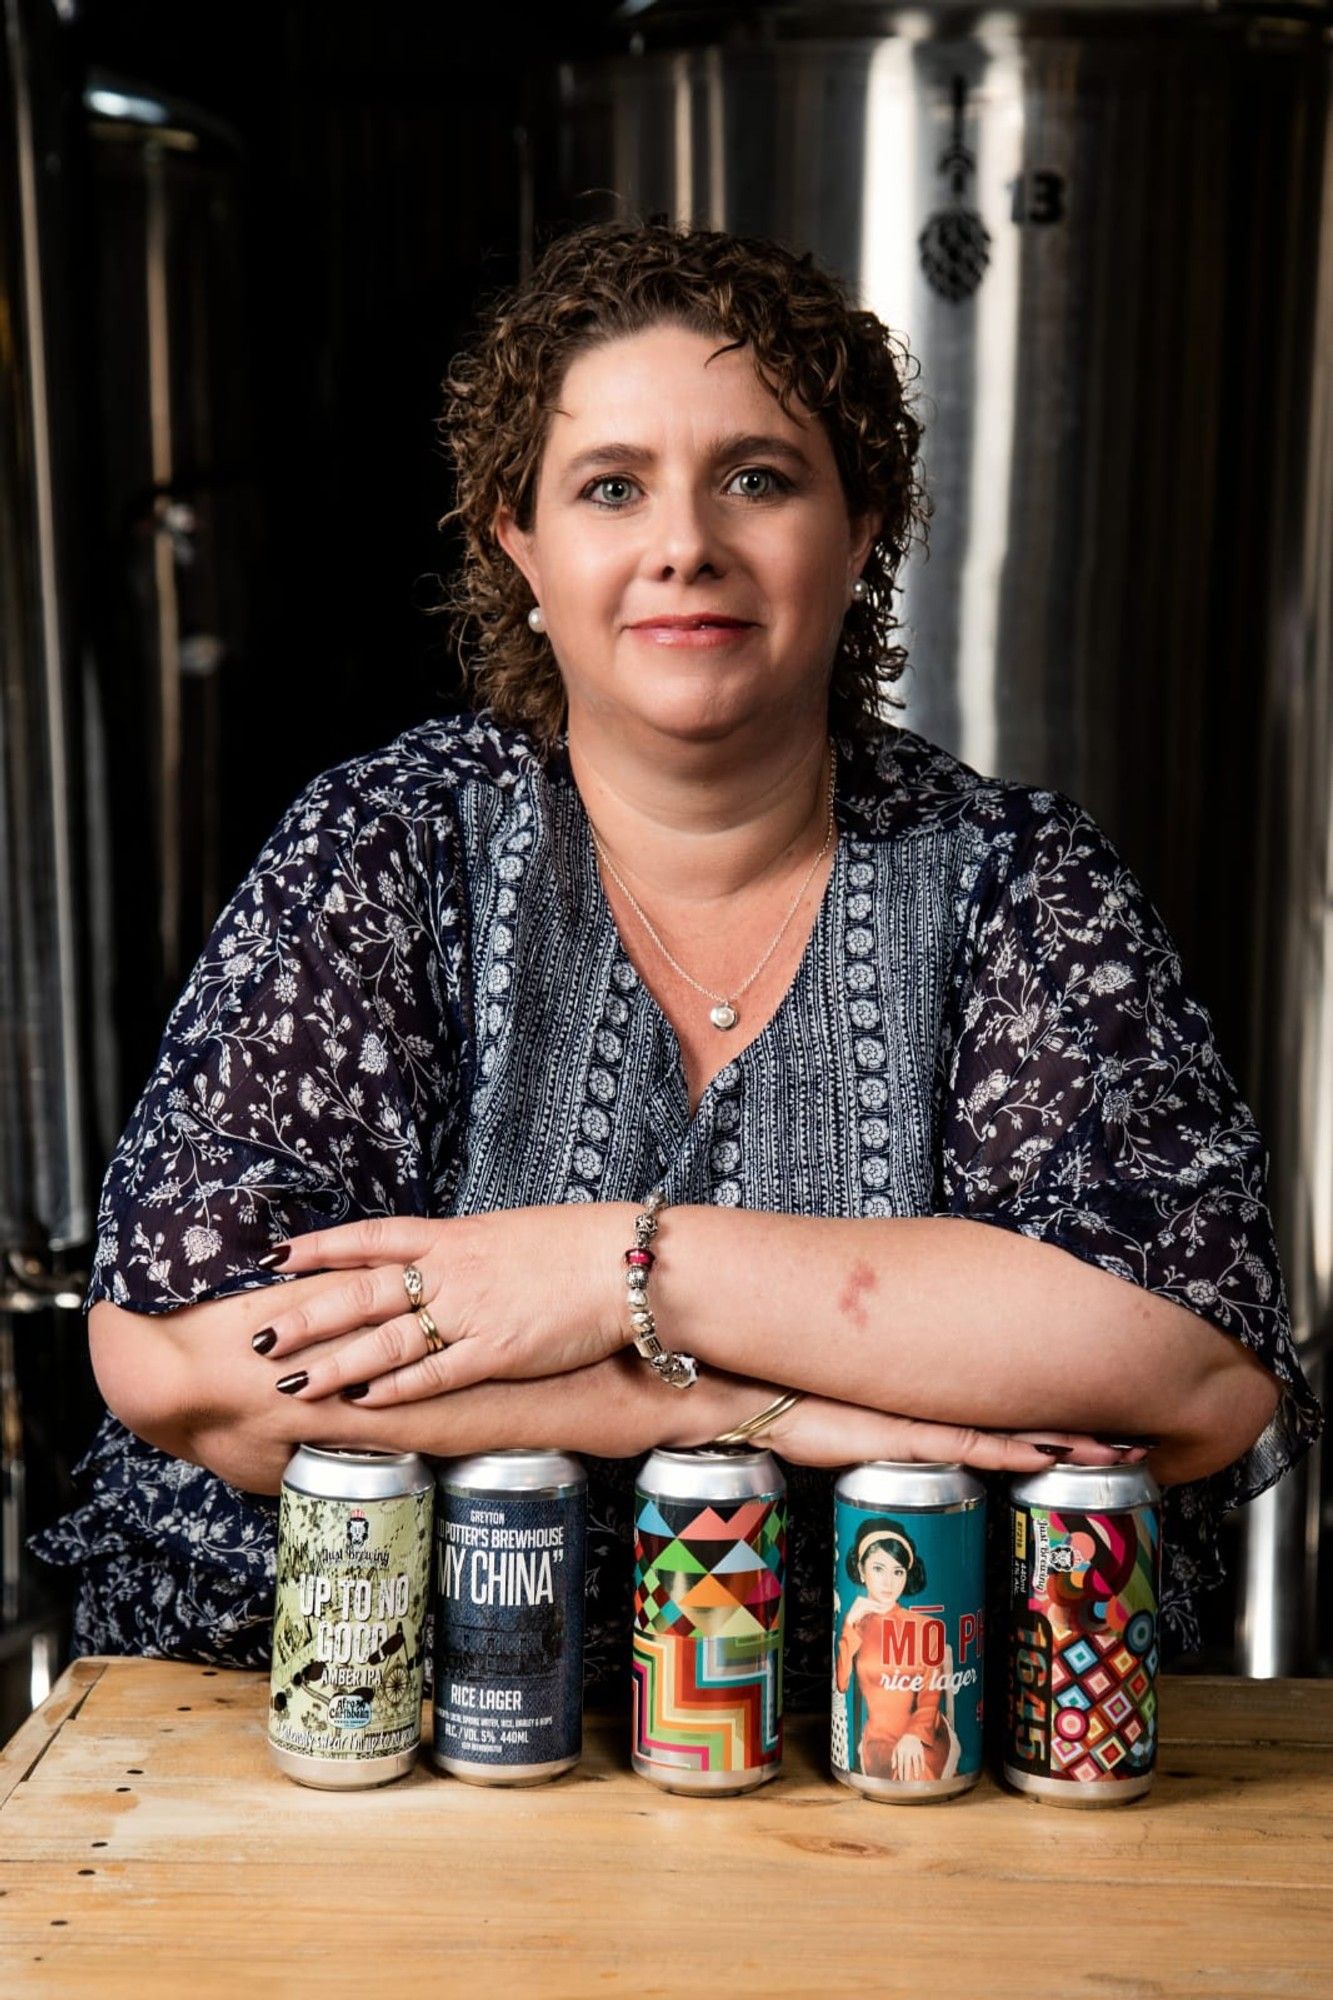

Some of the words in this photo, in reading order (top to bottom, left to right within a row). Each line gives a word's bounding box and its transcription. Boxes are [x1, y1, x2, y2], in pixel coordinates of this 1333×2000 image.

[470, 1510, 505, 1525] GREYTON
[445, 1521, 489, 1548] POTTER'S
[491, 1526, 564, 1549] BREWHOUSE
[300, 1573, 332, 1618] UP
[337, 1578, 372, 1622] TO
[378, 1574, 410, 1620] NO
[322, 1667, 361, 1686] AMBER
[364, 1667, 383, 1686] IPA
[880, 1669, 925, 1691] rice
[928, 1667, 977, 1695] lager
[451, 1683, 477, 1708] RICE
[480, 1688, 522, 1711] LAGER
[500, 1730, 529, 1743] 440ML
